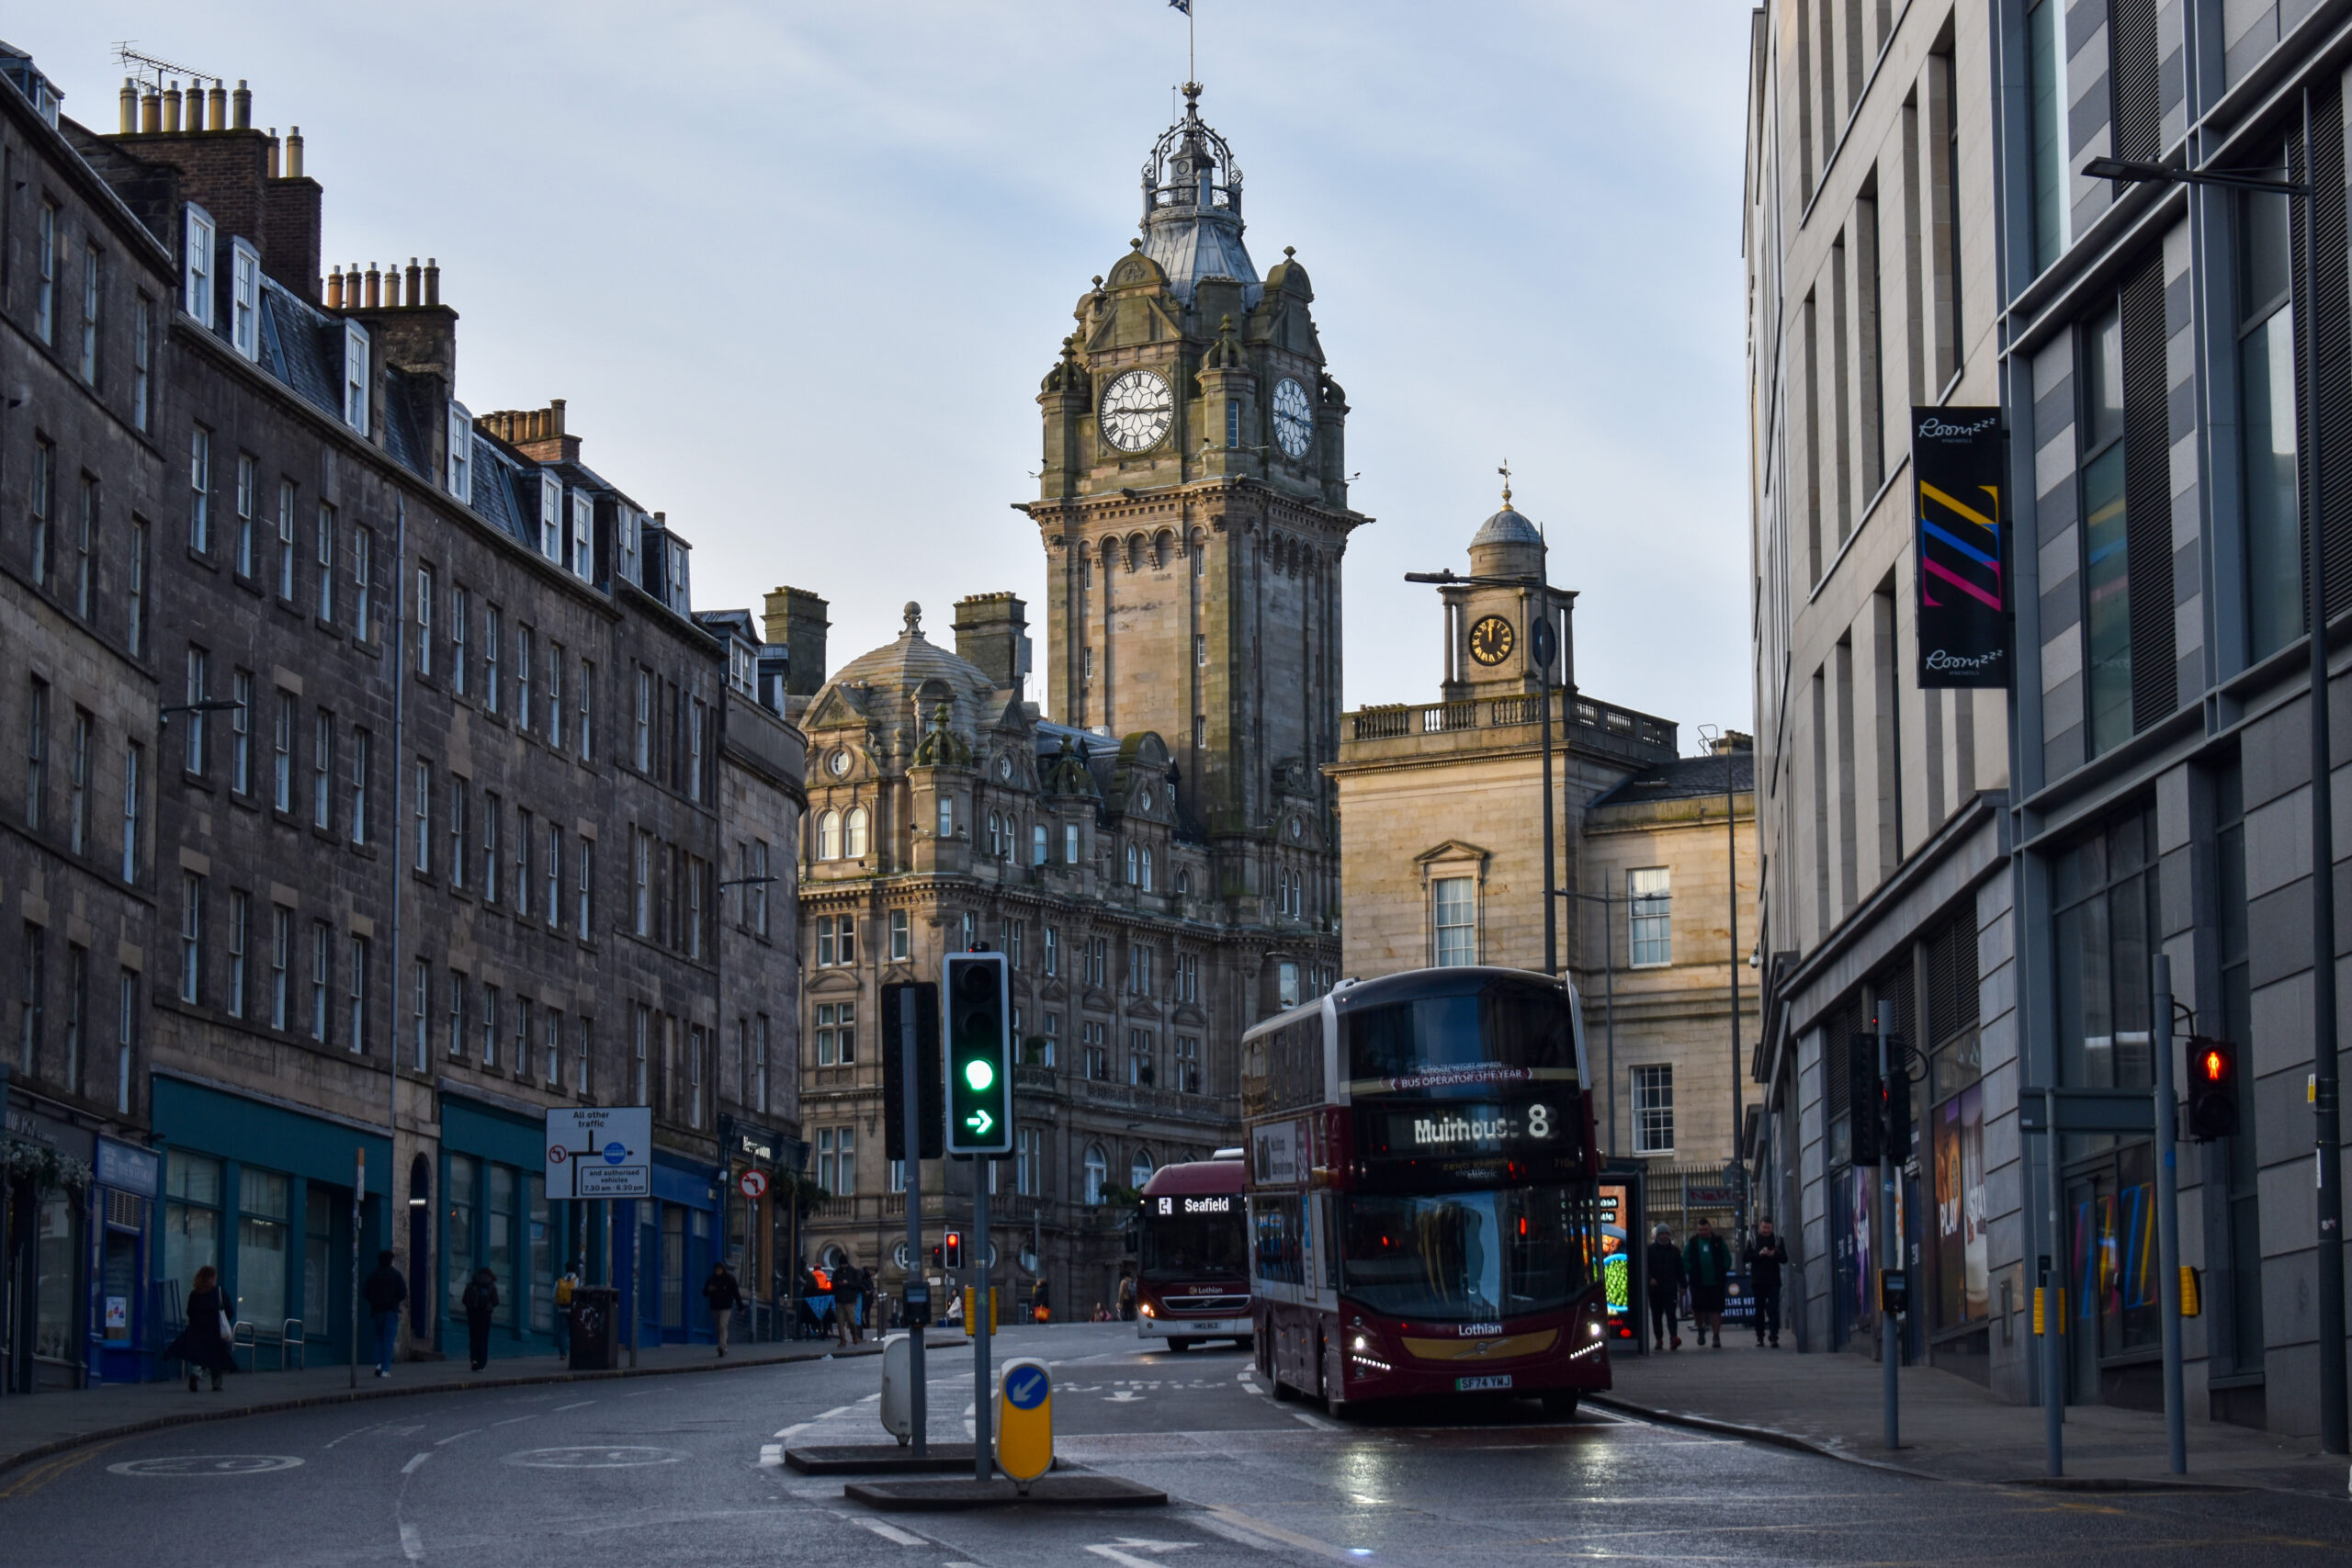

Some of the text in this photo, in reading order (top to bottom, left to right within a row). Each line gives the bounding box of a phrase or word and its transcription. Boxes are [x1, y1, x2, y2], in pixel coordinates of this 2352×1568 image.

[1401, 1078, 1421, 1089] BUS
[1422, 1073, 1474, 1087] OPERATOR
[1498, 1068, 1522, 1079] YEAR
[572, 1111, 610, 1120] All other
[1528, 1103, 1550, 1139] 8
[578, 1120, 605, 1128] traffic
[604, 1168, 639, 1177] authorised
[601, 1176, 628, 1184] vehicles
[1184, 1197, 1229, 1214] Seafield
[1939, 1196, 1959, 1238] PLAY
[1198, 1286, 1224, 1295] Lothian
[1458, 1323, 1502, 1337] Lothian
[1462, 1378, 1487, 1389] SF74
